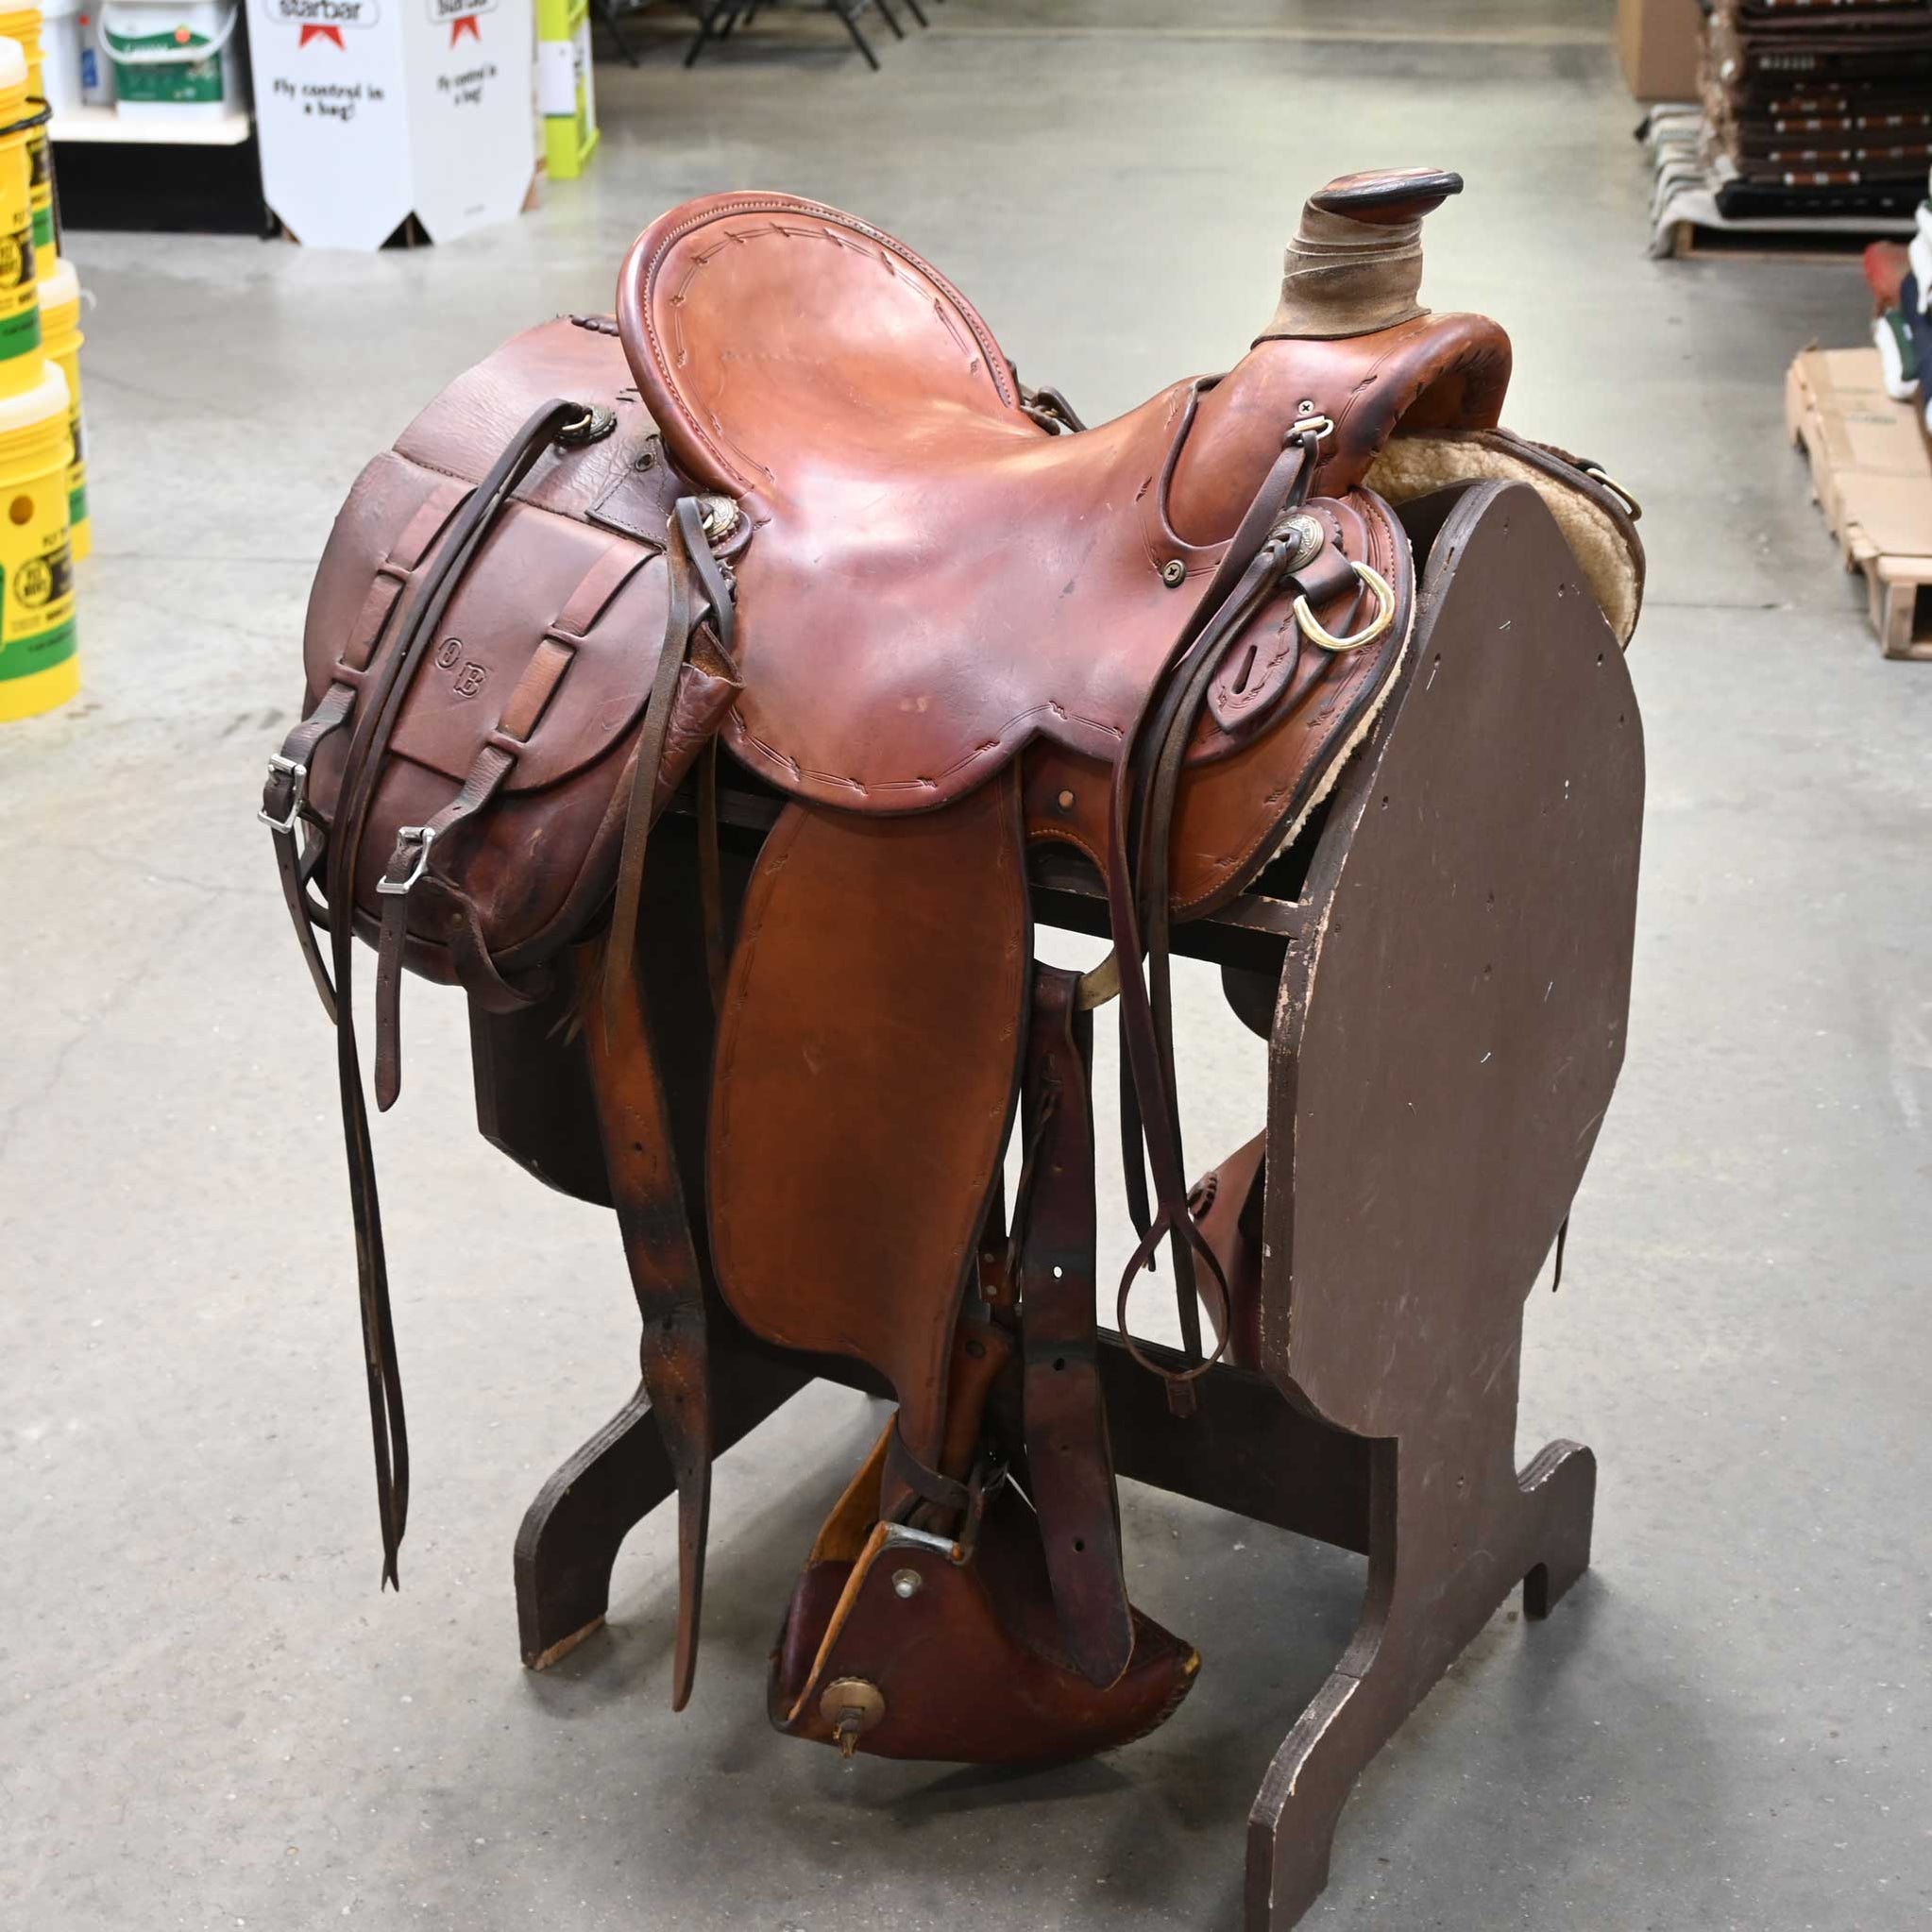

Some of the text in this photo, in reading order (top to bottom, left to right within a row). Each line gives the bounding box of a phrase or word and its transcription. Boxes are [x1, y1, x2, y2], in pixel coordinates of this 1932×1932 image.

[274, 78, 384, 100] Fly control in
